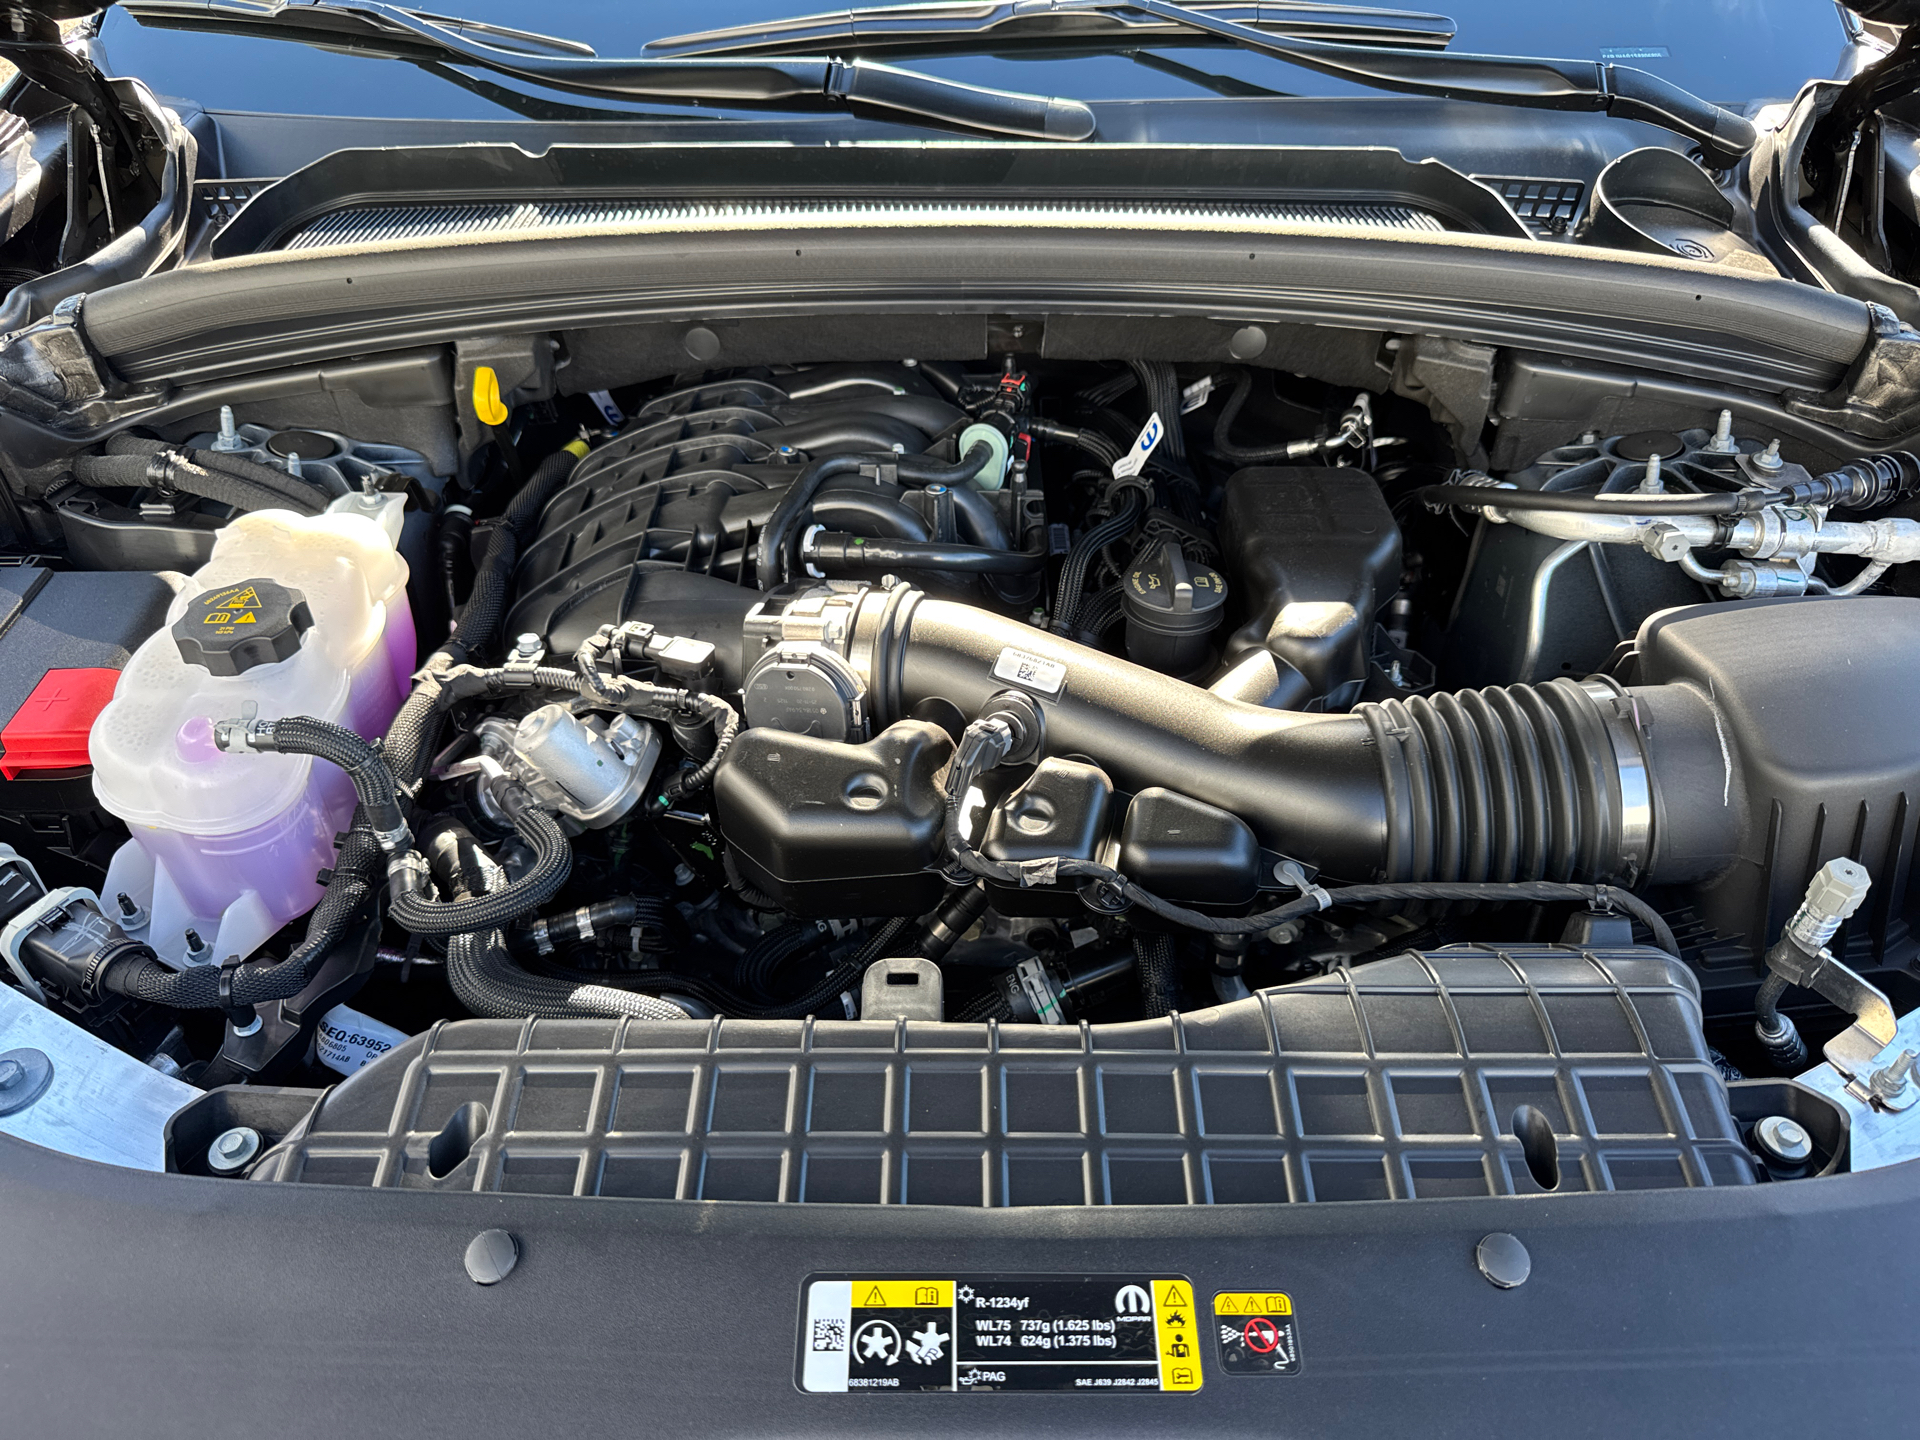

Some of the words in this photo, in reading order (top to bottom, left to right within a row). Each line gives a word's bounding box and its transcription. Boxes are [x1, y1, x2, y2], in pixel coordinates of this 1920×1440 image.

[1006, 973, 1020, 994] ENG
[320, 1021, 392, 1053] SEQ:63952
[975, 1297, 1030, 1310] R-1234yf
[975, 1320, 1011, 1331] WL75
[1020, 1320, 1050, 1333] 737g
[1052, 1320, 1090, 1333] (1.625
[1091, 1319, 1116, 1333] lbs)
[975, 1335, 1012, 1347] WL74
[1020, 1335, 1051, 1348] 624g
[1053, 1335, 1091, 1349] (1.375
[1092, 1335, 1117, 1349] lbs)
[848, 1378, 900, 1387] 68381219AB
[982, 1371, 1006, 1382] PAG
[1093, 1378, 1112, 1386] J639
[1112, 1378, 1136, 1386] J2842
[1136, 1378, 1159, 1386] J2845
